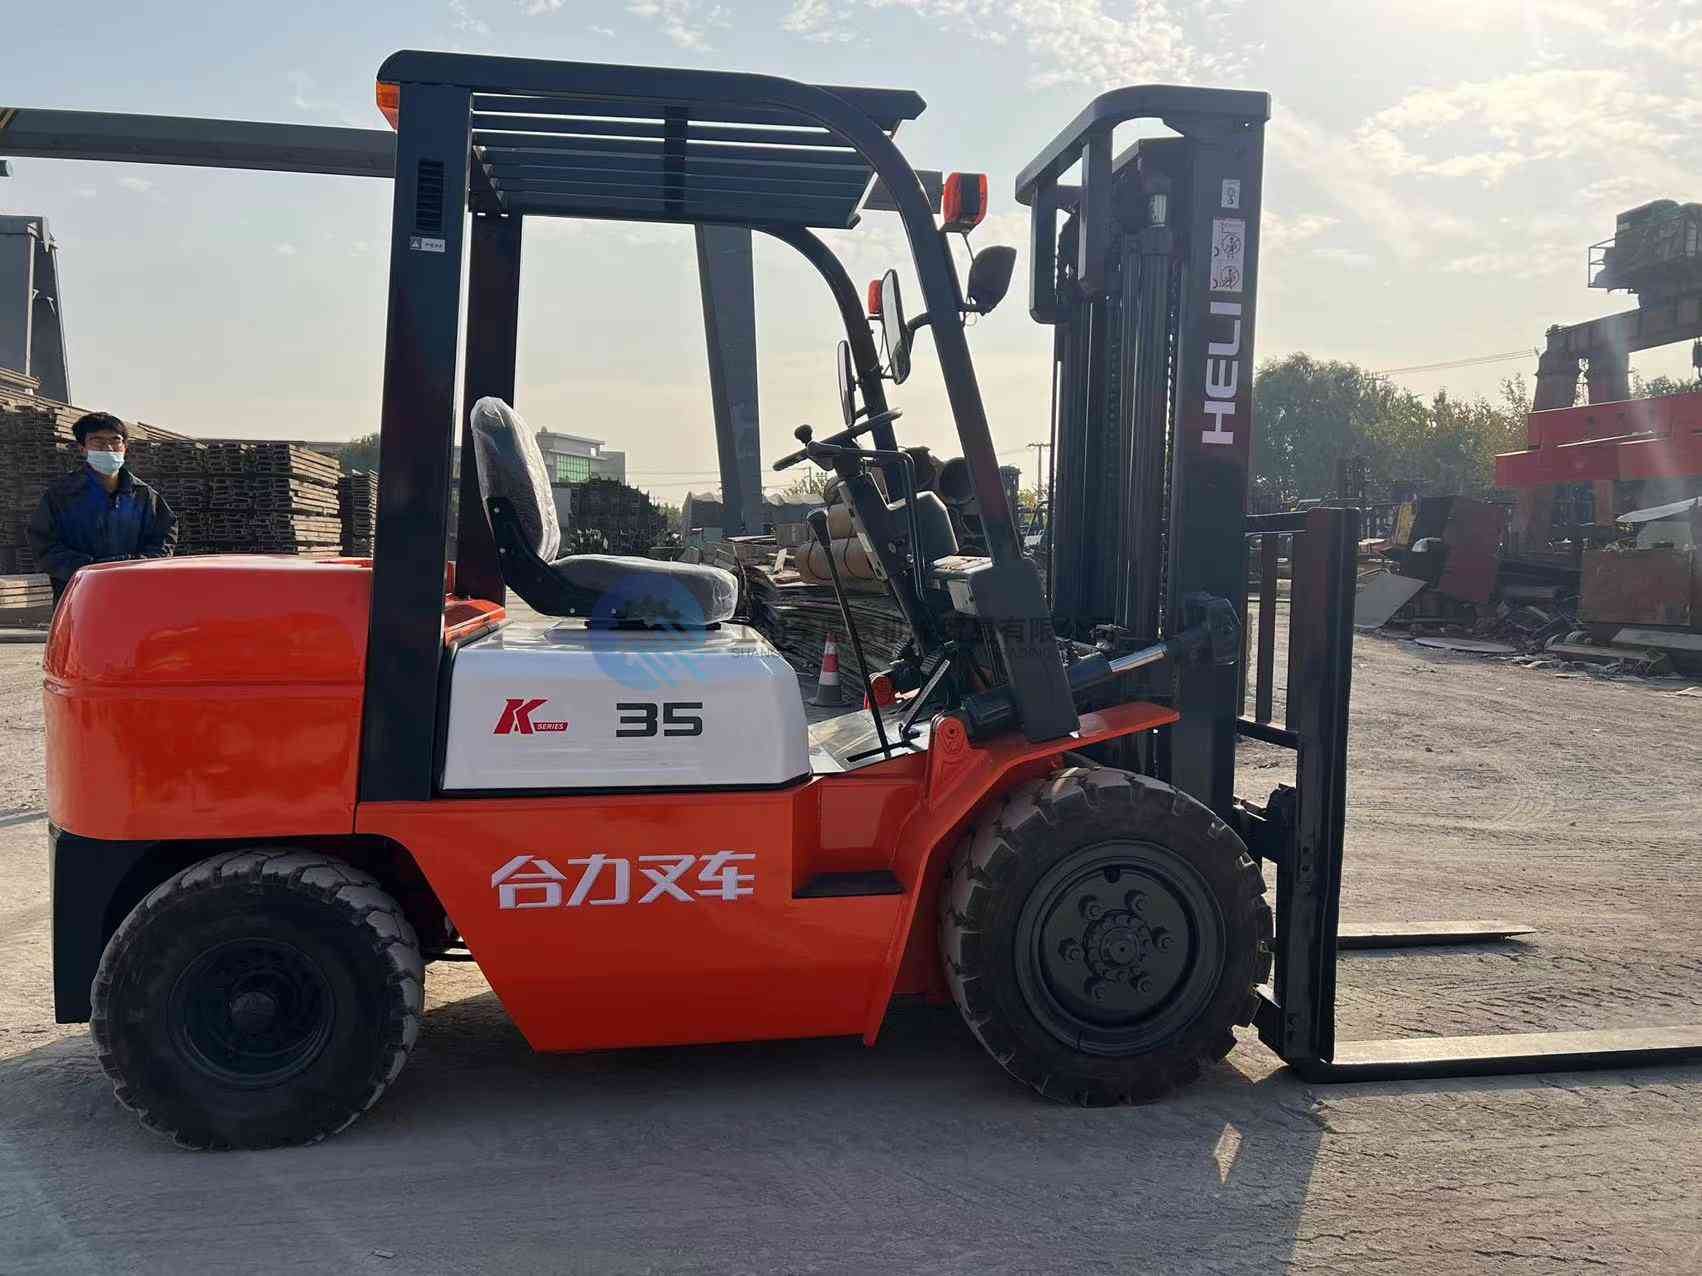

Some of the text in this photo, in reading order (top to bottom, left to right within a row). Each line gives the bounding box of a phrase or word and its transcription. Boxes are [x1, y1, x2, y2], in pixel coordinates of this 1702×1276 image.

[1202, 301, 1242, 445] HELI
[494, 698, 567, 735] K SERIES
[615, 702, 703, 738] 35
[491, 850, 757, 910] 合力叉车
